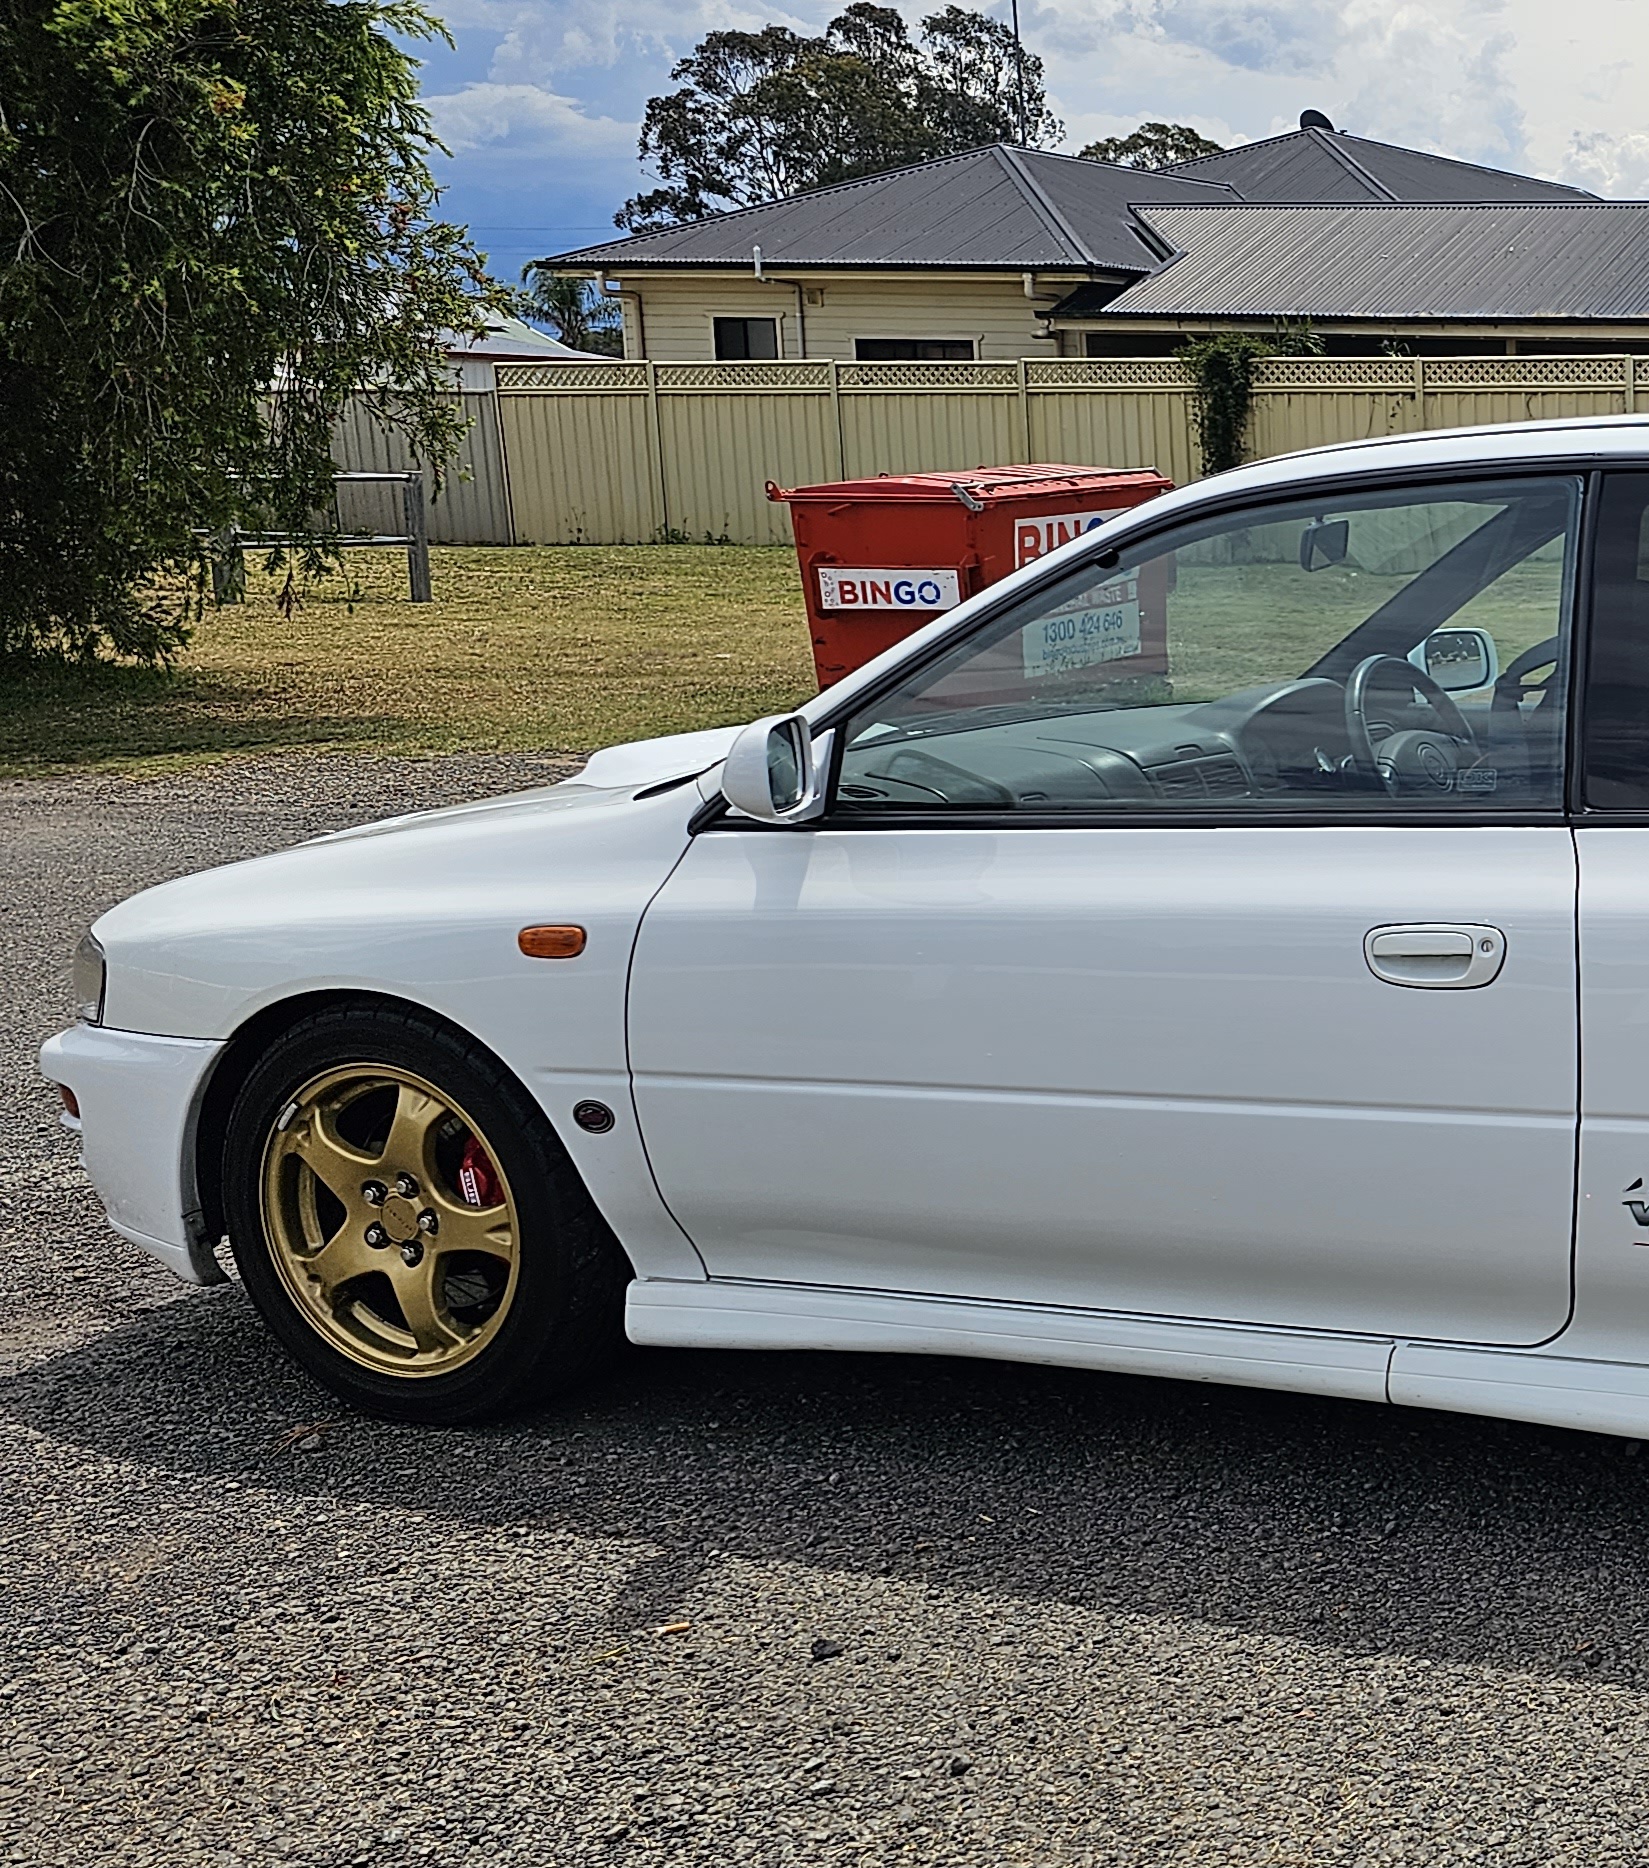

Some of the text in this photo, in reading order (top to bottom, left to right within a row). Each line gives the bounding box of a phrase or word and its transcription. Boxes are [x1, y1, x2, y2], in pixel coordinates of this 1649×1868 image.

[1018, 517, 1106, 568] BIN
[838, 580, 941, 605] BINGO
[1043, 610, 1123, 643] 1300 424 646
